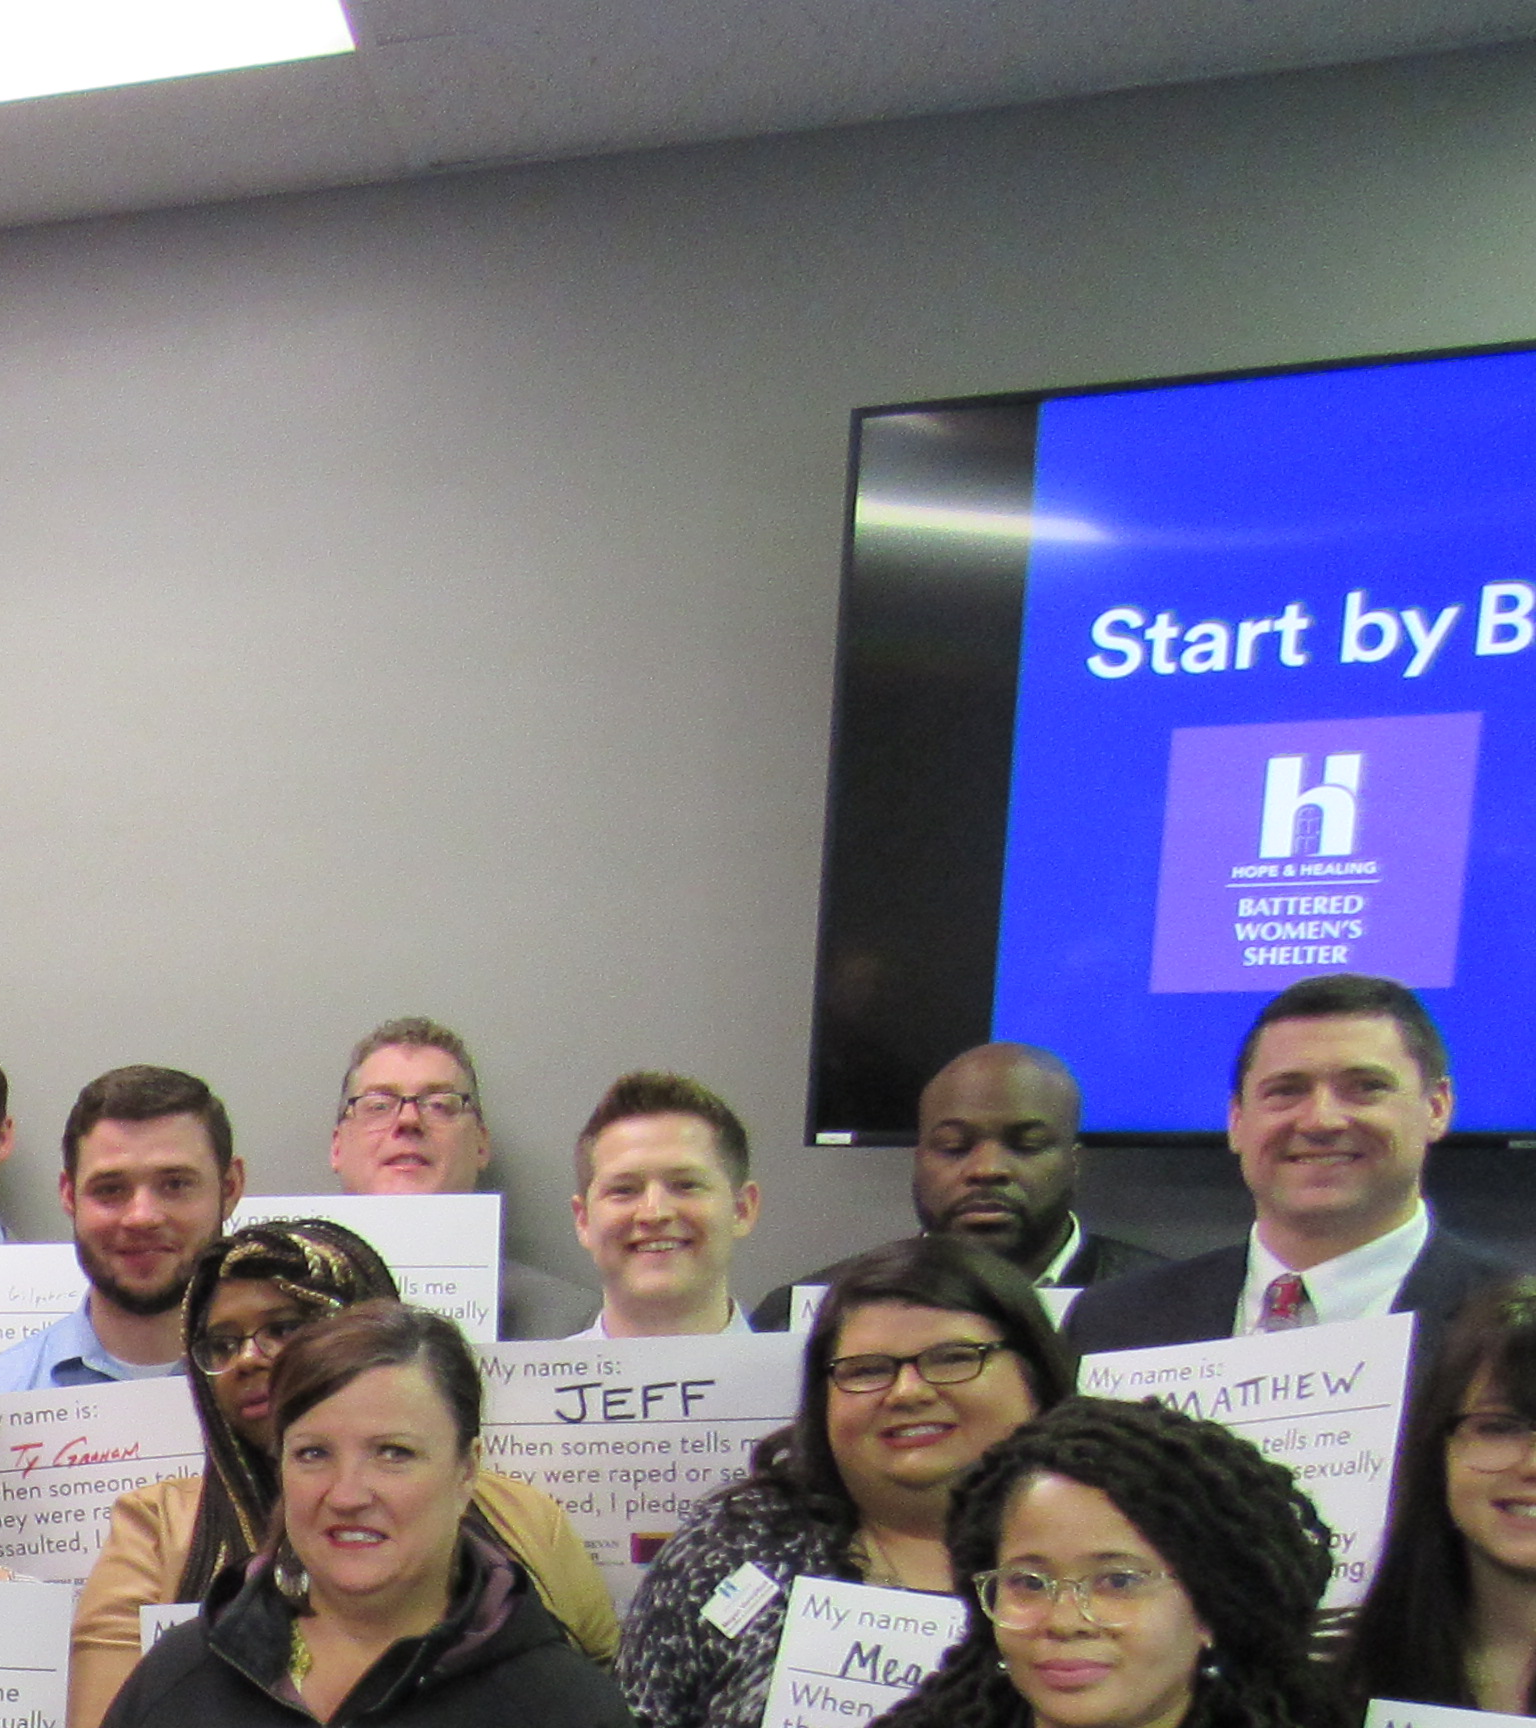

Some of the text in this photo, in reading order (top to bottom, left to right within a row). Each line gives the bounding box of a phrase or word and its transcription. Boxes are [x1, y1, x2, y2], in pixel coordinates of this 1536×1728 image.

[1087, 602, 1311, 678] Start
[1341, 589, 1460, 677] by
[1232, 862, 1377, 878] HOPE & HEALING
[1238, 895, 1364, 917] BATTERED
[1234, 919, 1363, 942] WOMEN'S
[1243, 944, 1348, 966] SHELTER
[480, 1354, 622, 1384] My name is:
[1085, 1367, 1123, 1393] My
[1130, 1366, 1192, 1386] name
[555, 1379, 716, 1424] JEFF
[483, 1431, 731, 1457] When someone tells
[1262, 1429, 1352, 1455] tells me
[1294, 1452, 1385, 1483] sexually
[801, 1593, 852, 1630] My
[858, 1610, 938, 1637] name
[840, 1641, 922, 1686] Mea
